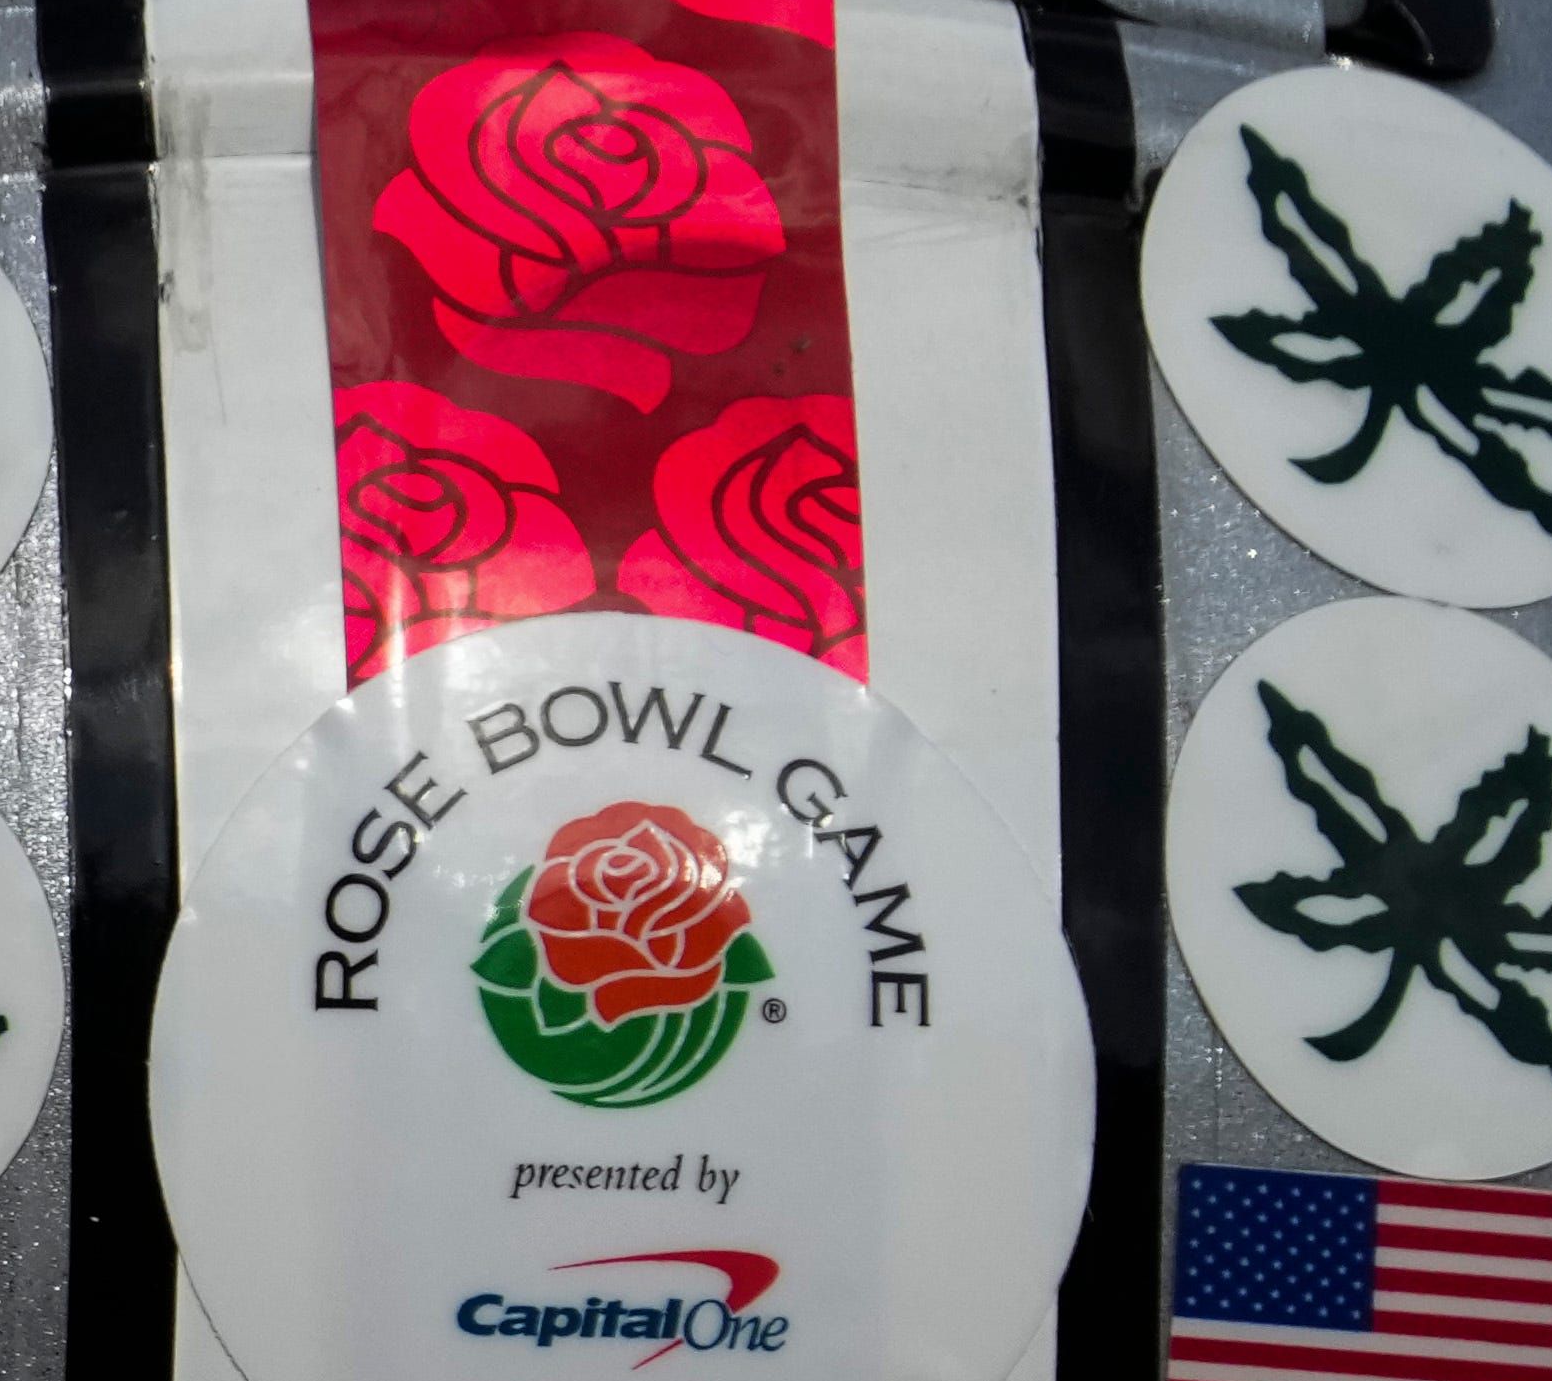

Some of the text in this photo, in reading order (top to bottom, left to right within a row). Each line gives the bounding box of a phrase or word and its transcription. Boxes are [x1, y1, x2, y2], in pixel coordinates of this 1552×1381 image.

[314, 681, 931, 1028] ROSE BOWL GAME
[509, 1153, 741, 1205] presented by
